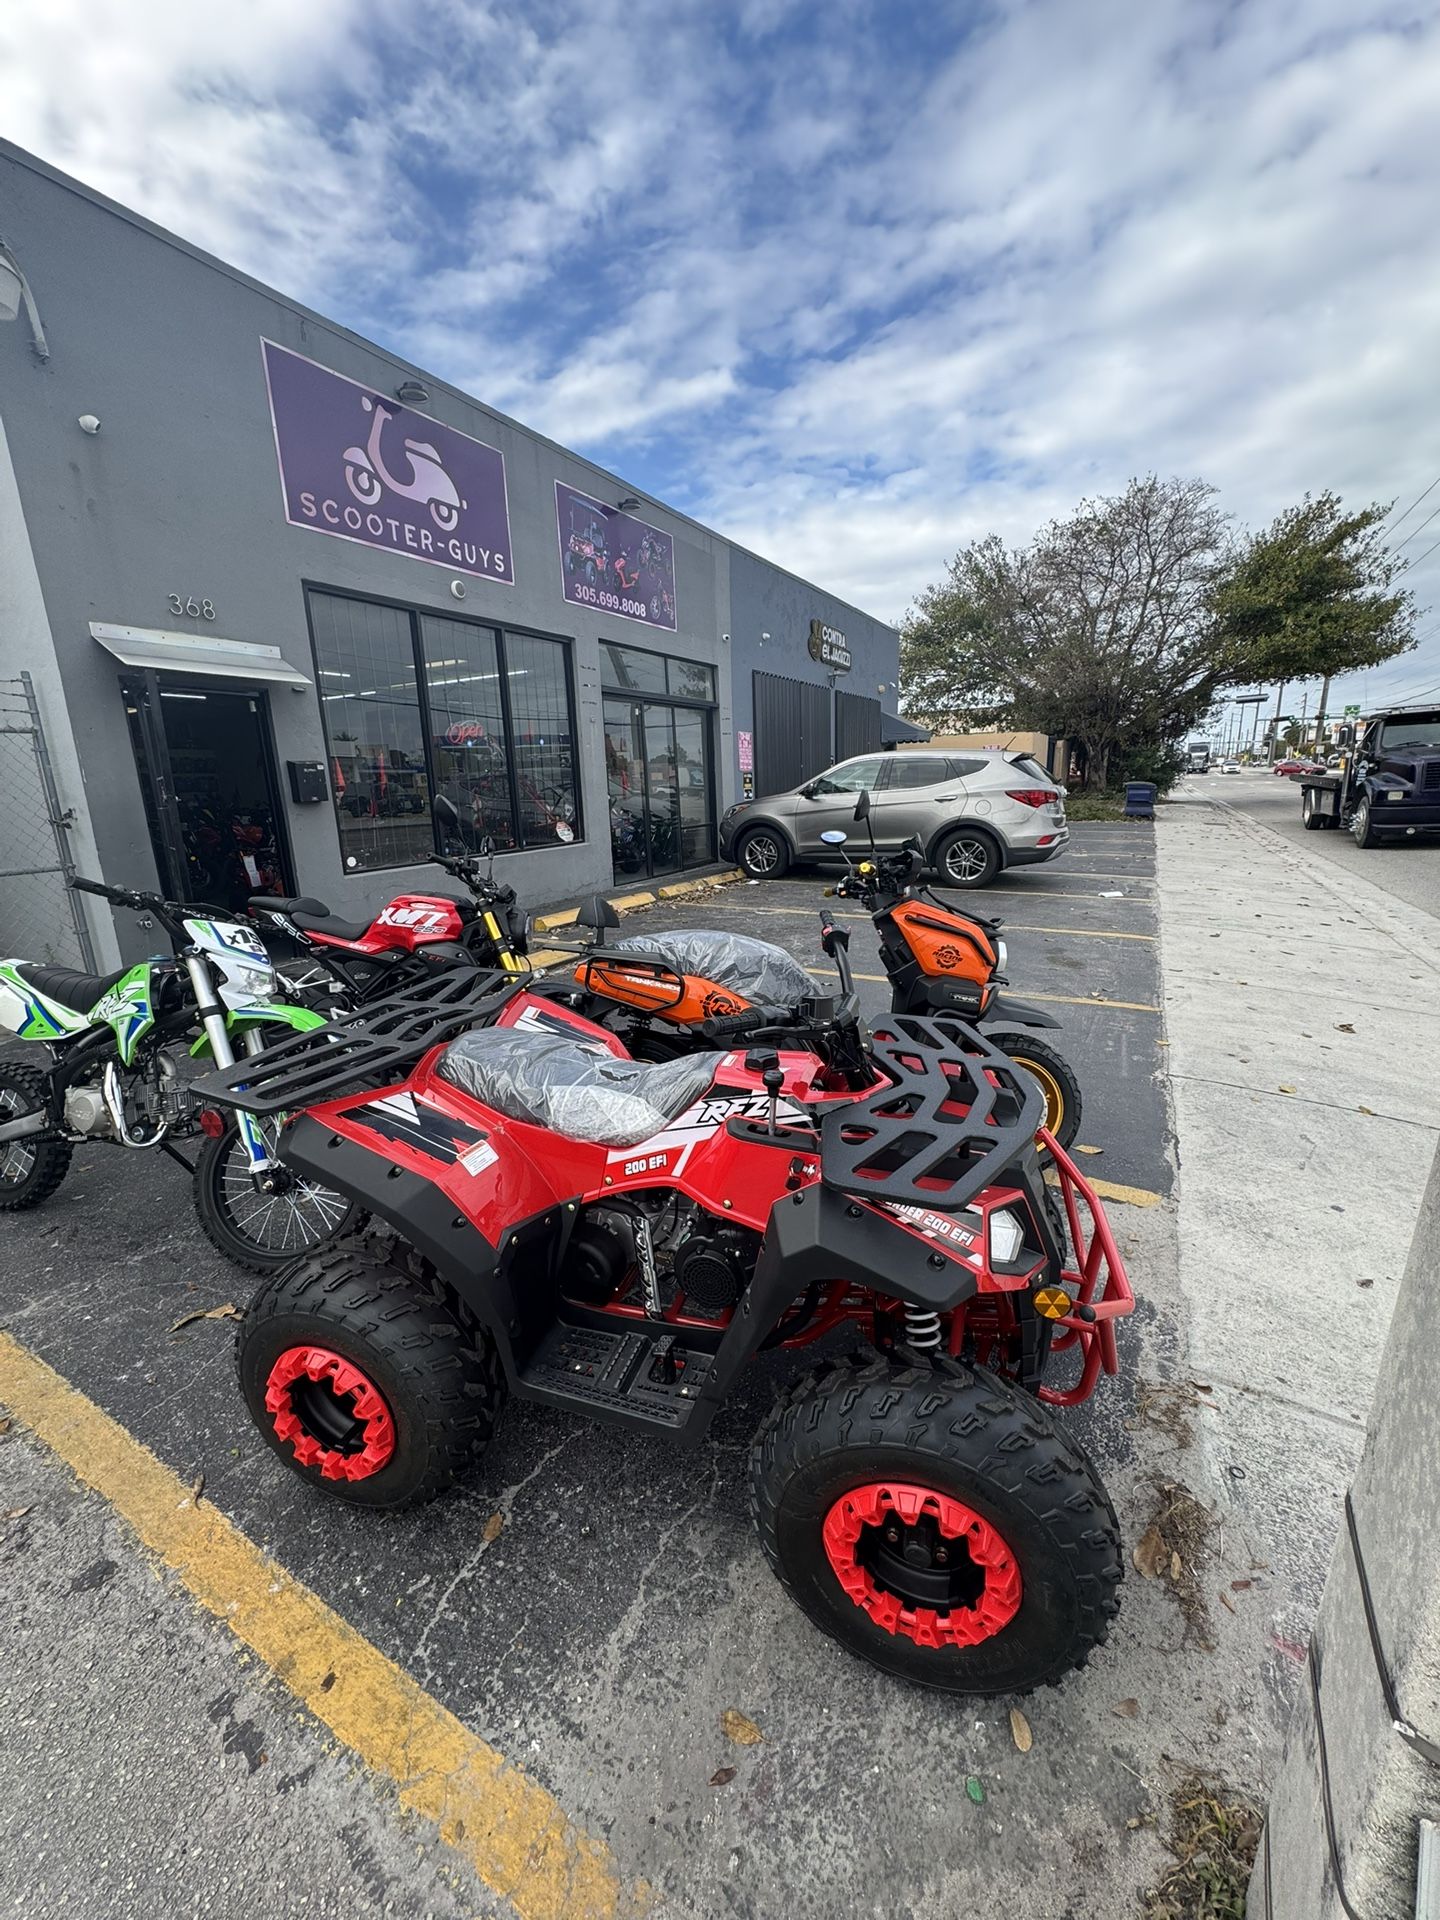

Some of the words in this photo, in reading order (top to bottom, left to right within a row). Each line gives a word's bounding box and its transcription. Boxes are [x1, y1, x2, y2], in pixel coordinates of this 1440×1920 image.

[300, 492, 505, 573] SCOOTER-GUYS
[168, 593, 216, 620] 368
[574, 583, 646, 617] 305.699.8008
[822, 626, 846, 648] CONTRA
[624, 1160, 647, 1175] 200
[648, 1154, 667, 1170] EFI
[923, 1213, 952, 1234] 200
[950, 1226, 975, 1247] EFI
